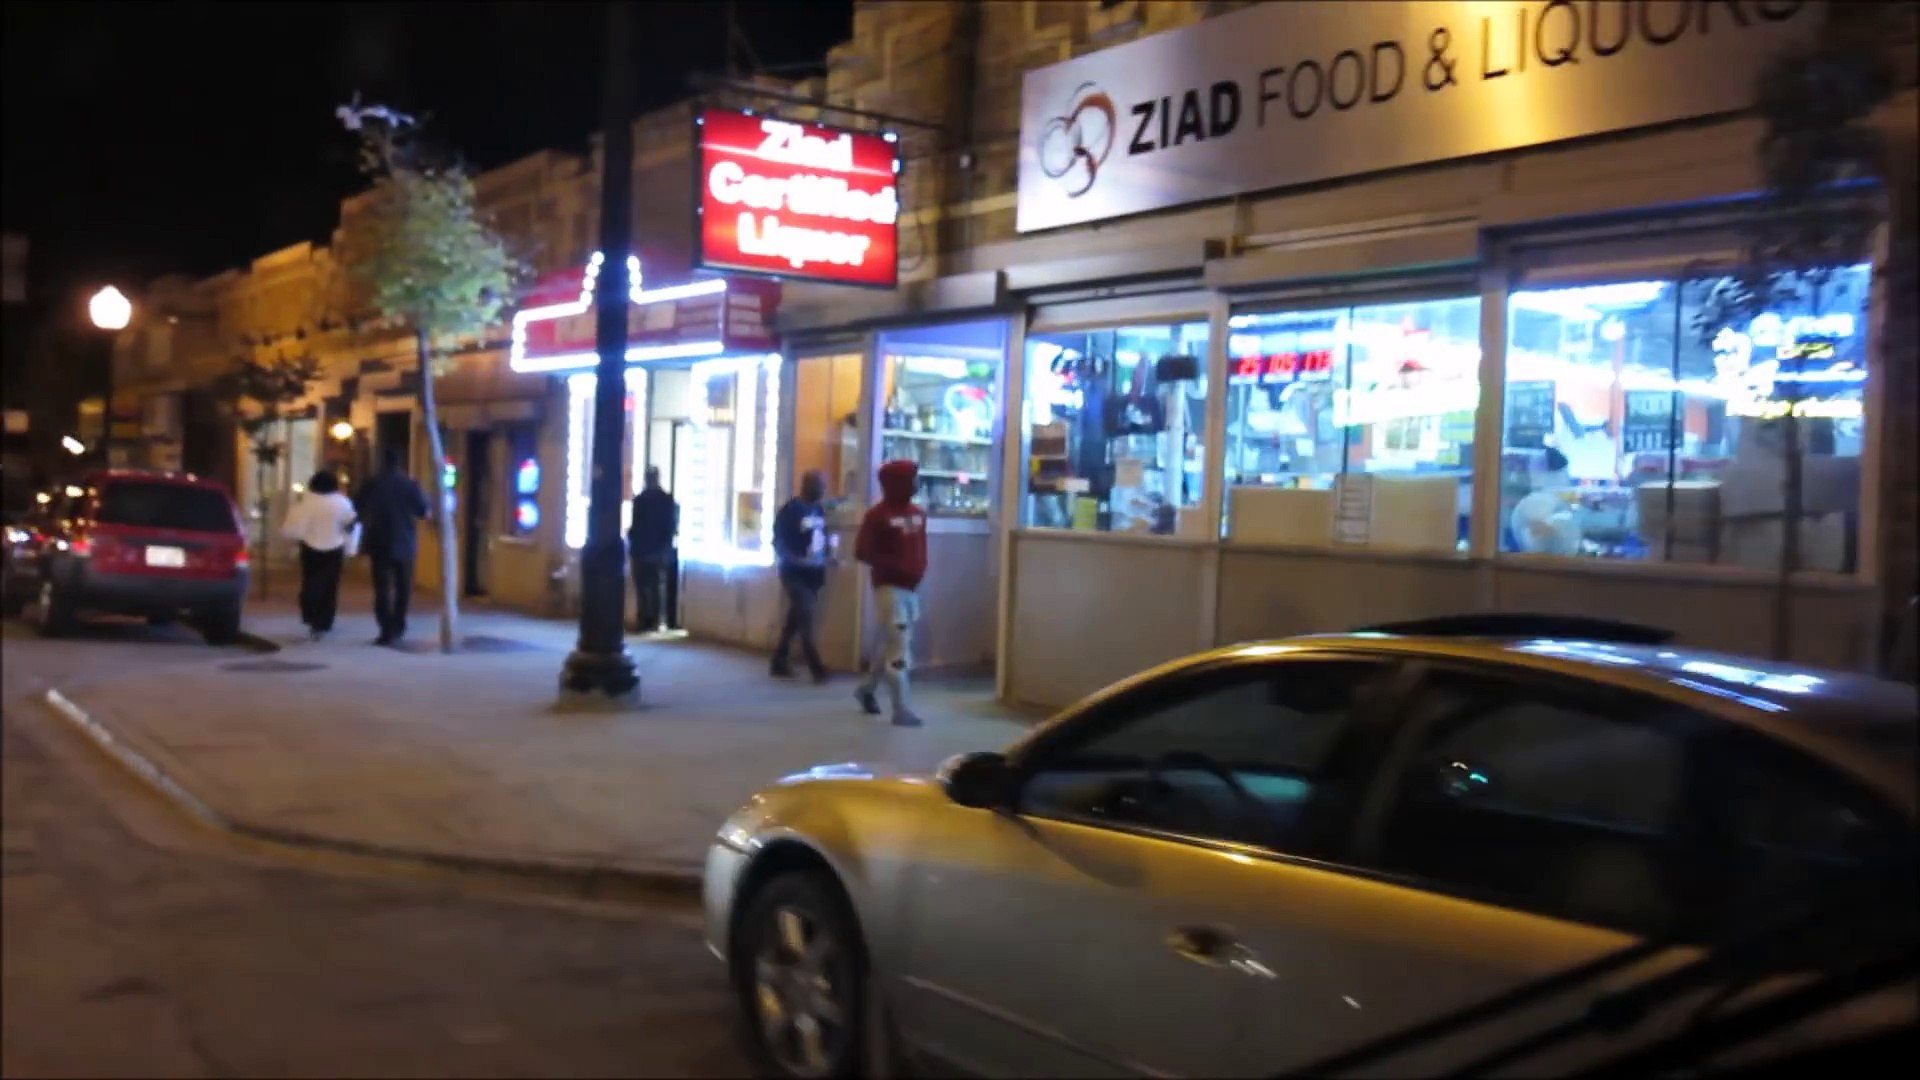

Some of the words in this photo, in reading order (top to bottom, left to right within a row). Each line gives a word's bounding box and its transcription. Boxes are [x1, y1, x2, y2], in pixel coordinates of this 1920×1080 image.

[1128, 80, 1241, 155] ZIAD
[1257, 40, 1406, 128] FOOD
[1423, 27, 1457, 91] &
[758, 119, 853, 172] Ziad
[709, 161, 897, 224] Certified
[737, 212, 870, 268] Liquor
